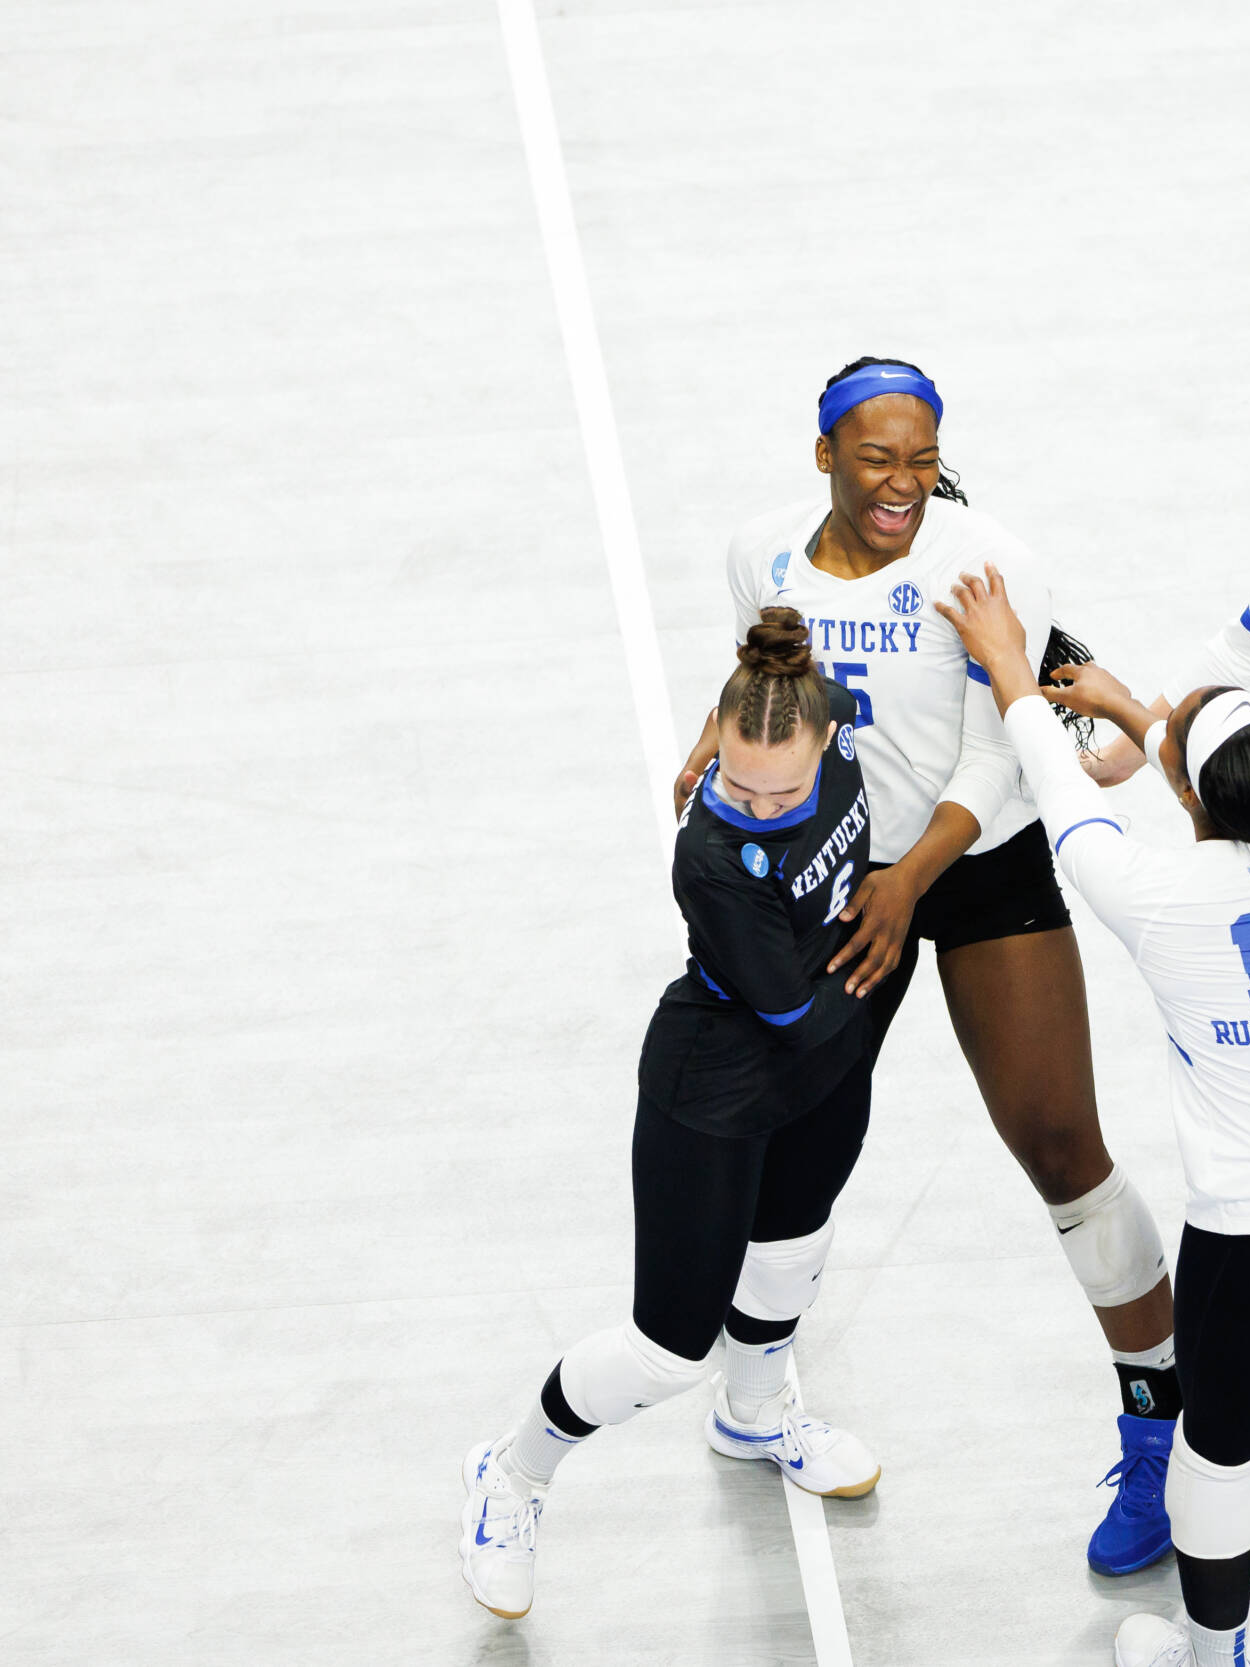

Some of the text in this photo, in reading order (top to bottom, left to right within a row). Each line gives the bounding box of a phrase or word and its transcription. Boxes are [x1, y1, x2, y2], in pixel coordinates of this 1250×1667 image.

[891, 583, 921, 613] SEC
[815, 661, 875, 730] 5
[790, 788, 869, 900] KENTUCKY
[822, 860, 854, 926] 6
